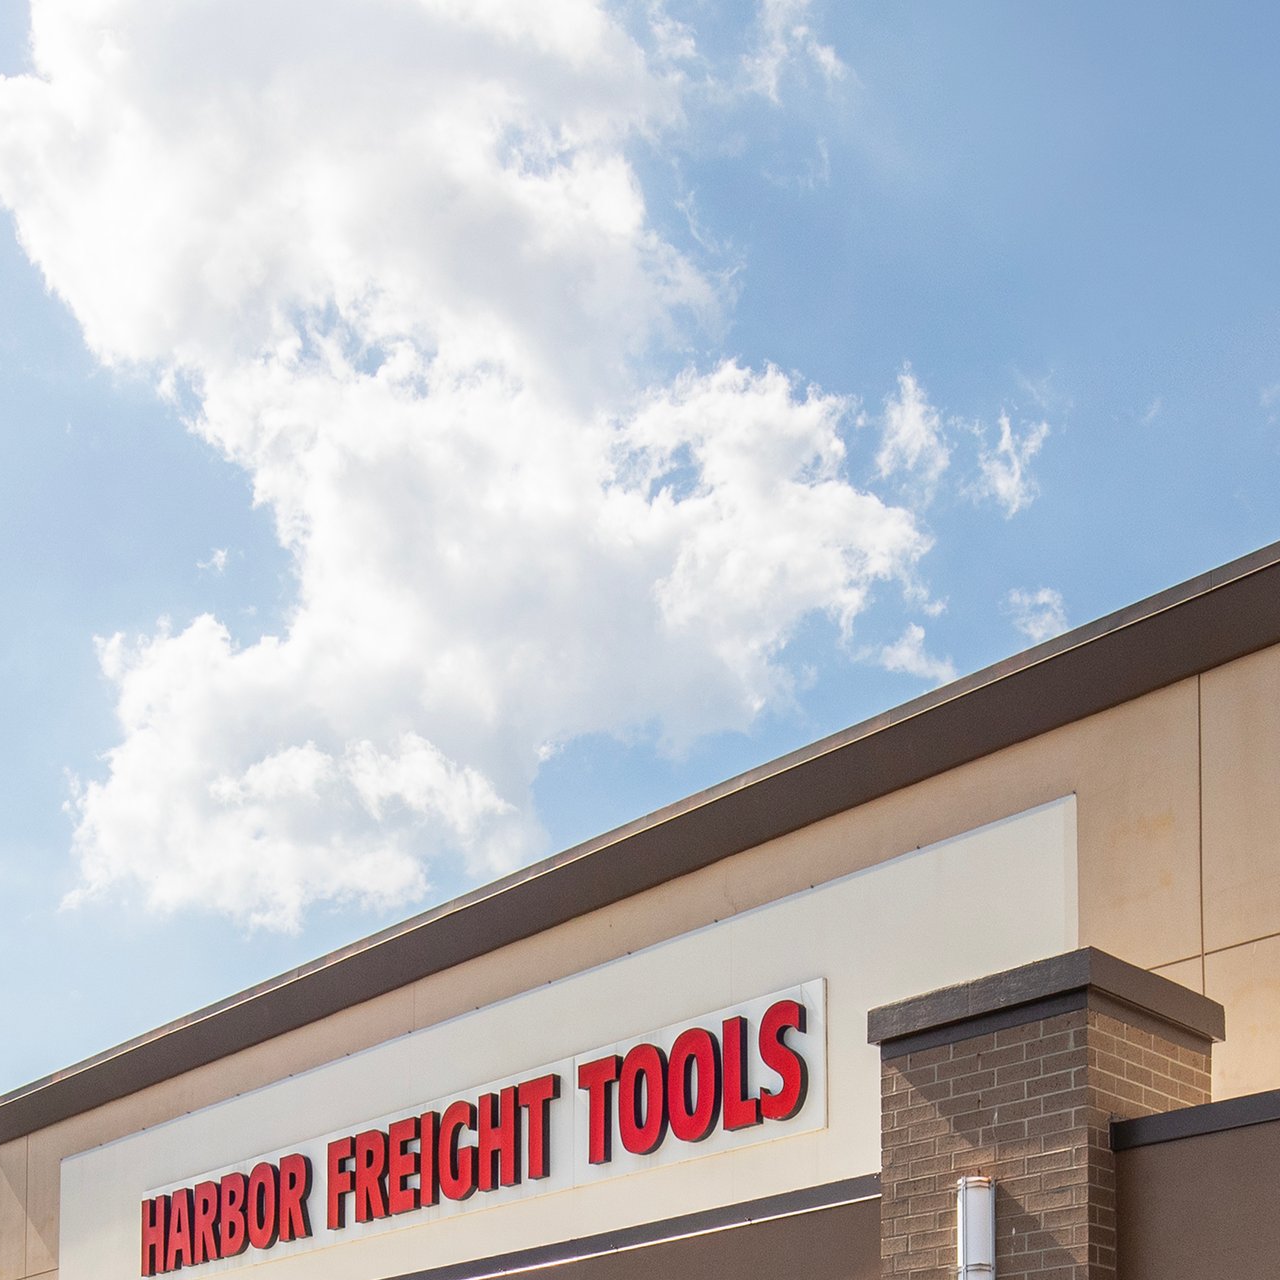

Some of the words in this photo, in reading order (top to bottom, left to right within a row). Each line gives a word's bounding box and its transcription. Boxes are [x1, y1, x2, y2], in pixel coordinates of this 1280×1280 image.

[141, 1153, 313, 1277] HARBOR
[327, 1073, 561, 1230] FREIGHT
[578, 999, 809, 1165] TOOLS
